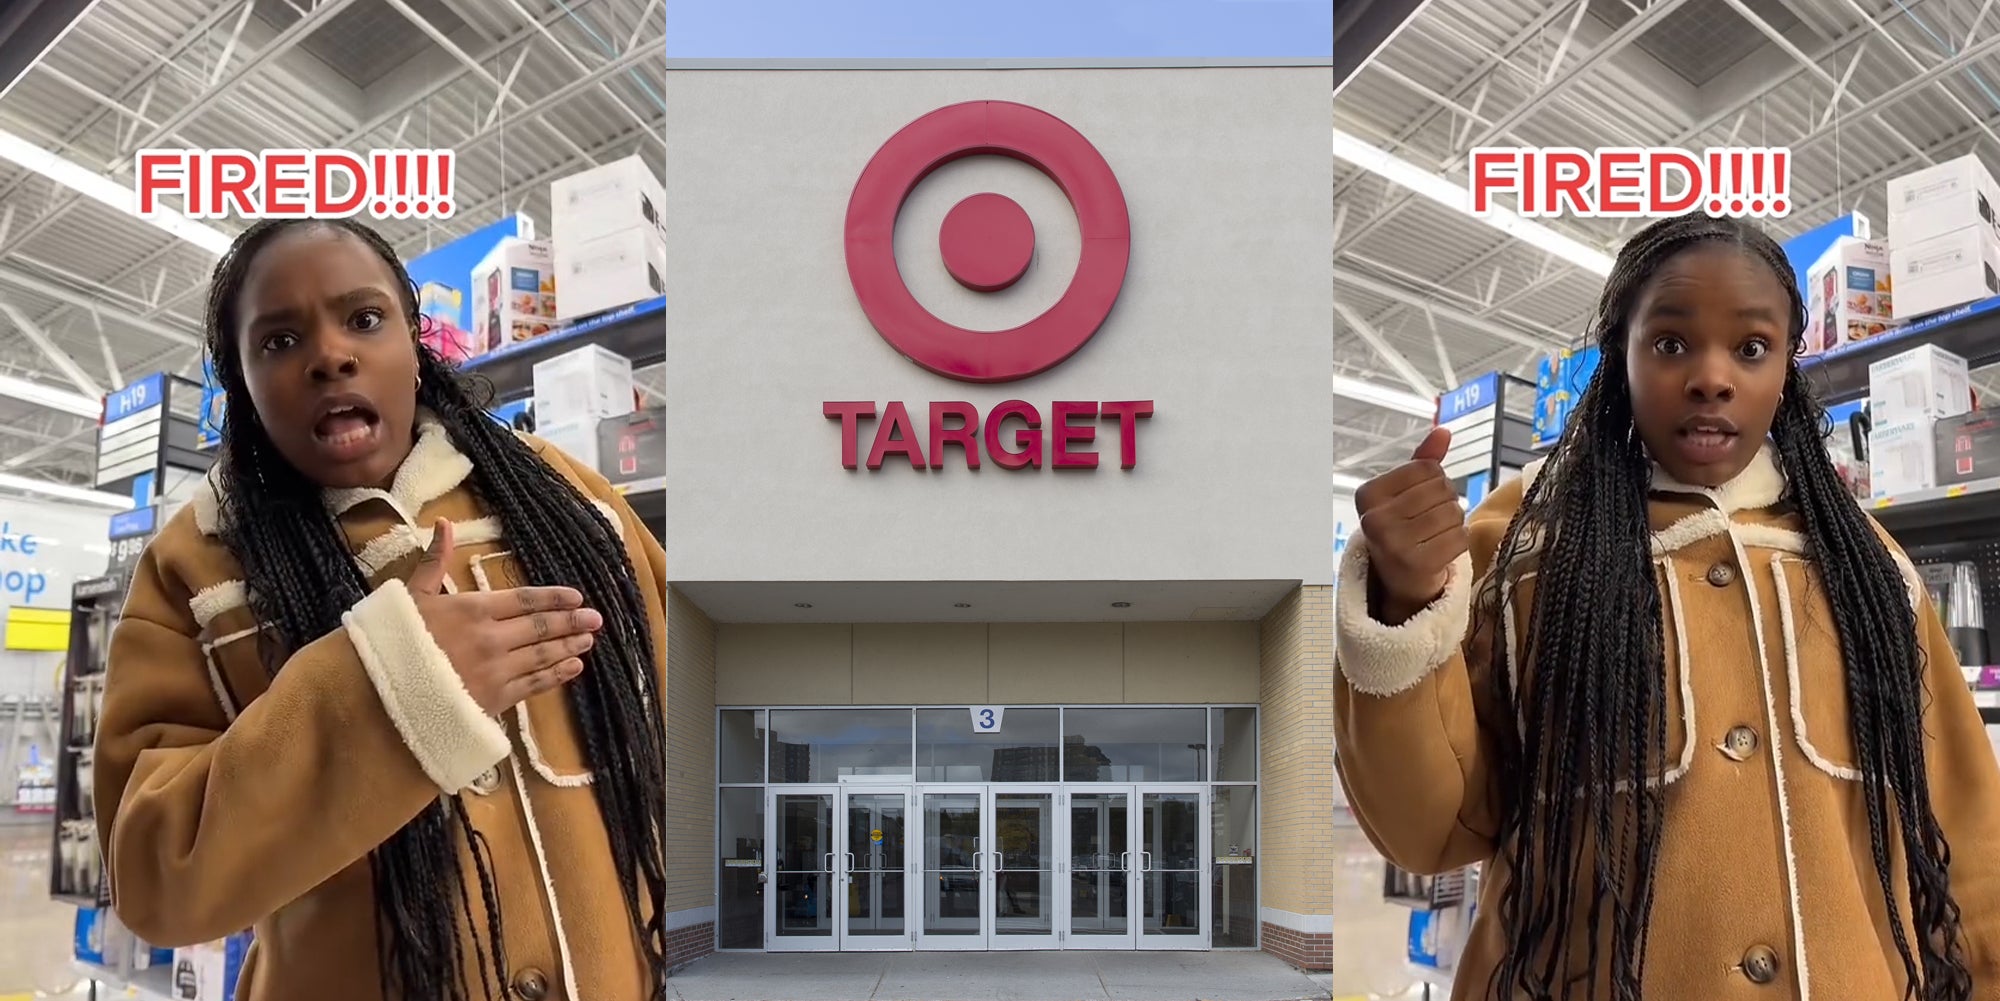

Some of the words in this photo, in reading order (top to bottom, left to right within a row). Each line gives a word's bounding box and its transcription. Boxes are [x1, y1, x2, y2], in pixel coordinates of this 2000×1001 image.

[120, 384, 146, 414] H19
[1454, 383, 1480, 414] H19
[823, 400, 1154, 469] TARGET
[0, 571, 46, 604] op
[979, 708, 995, 729] 3
